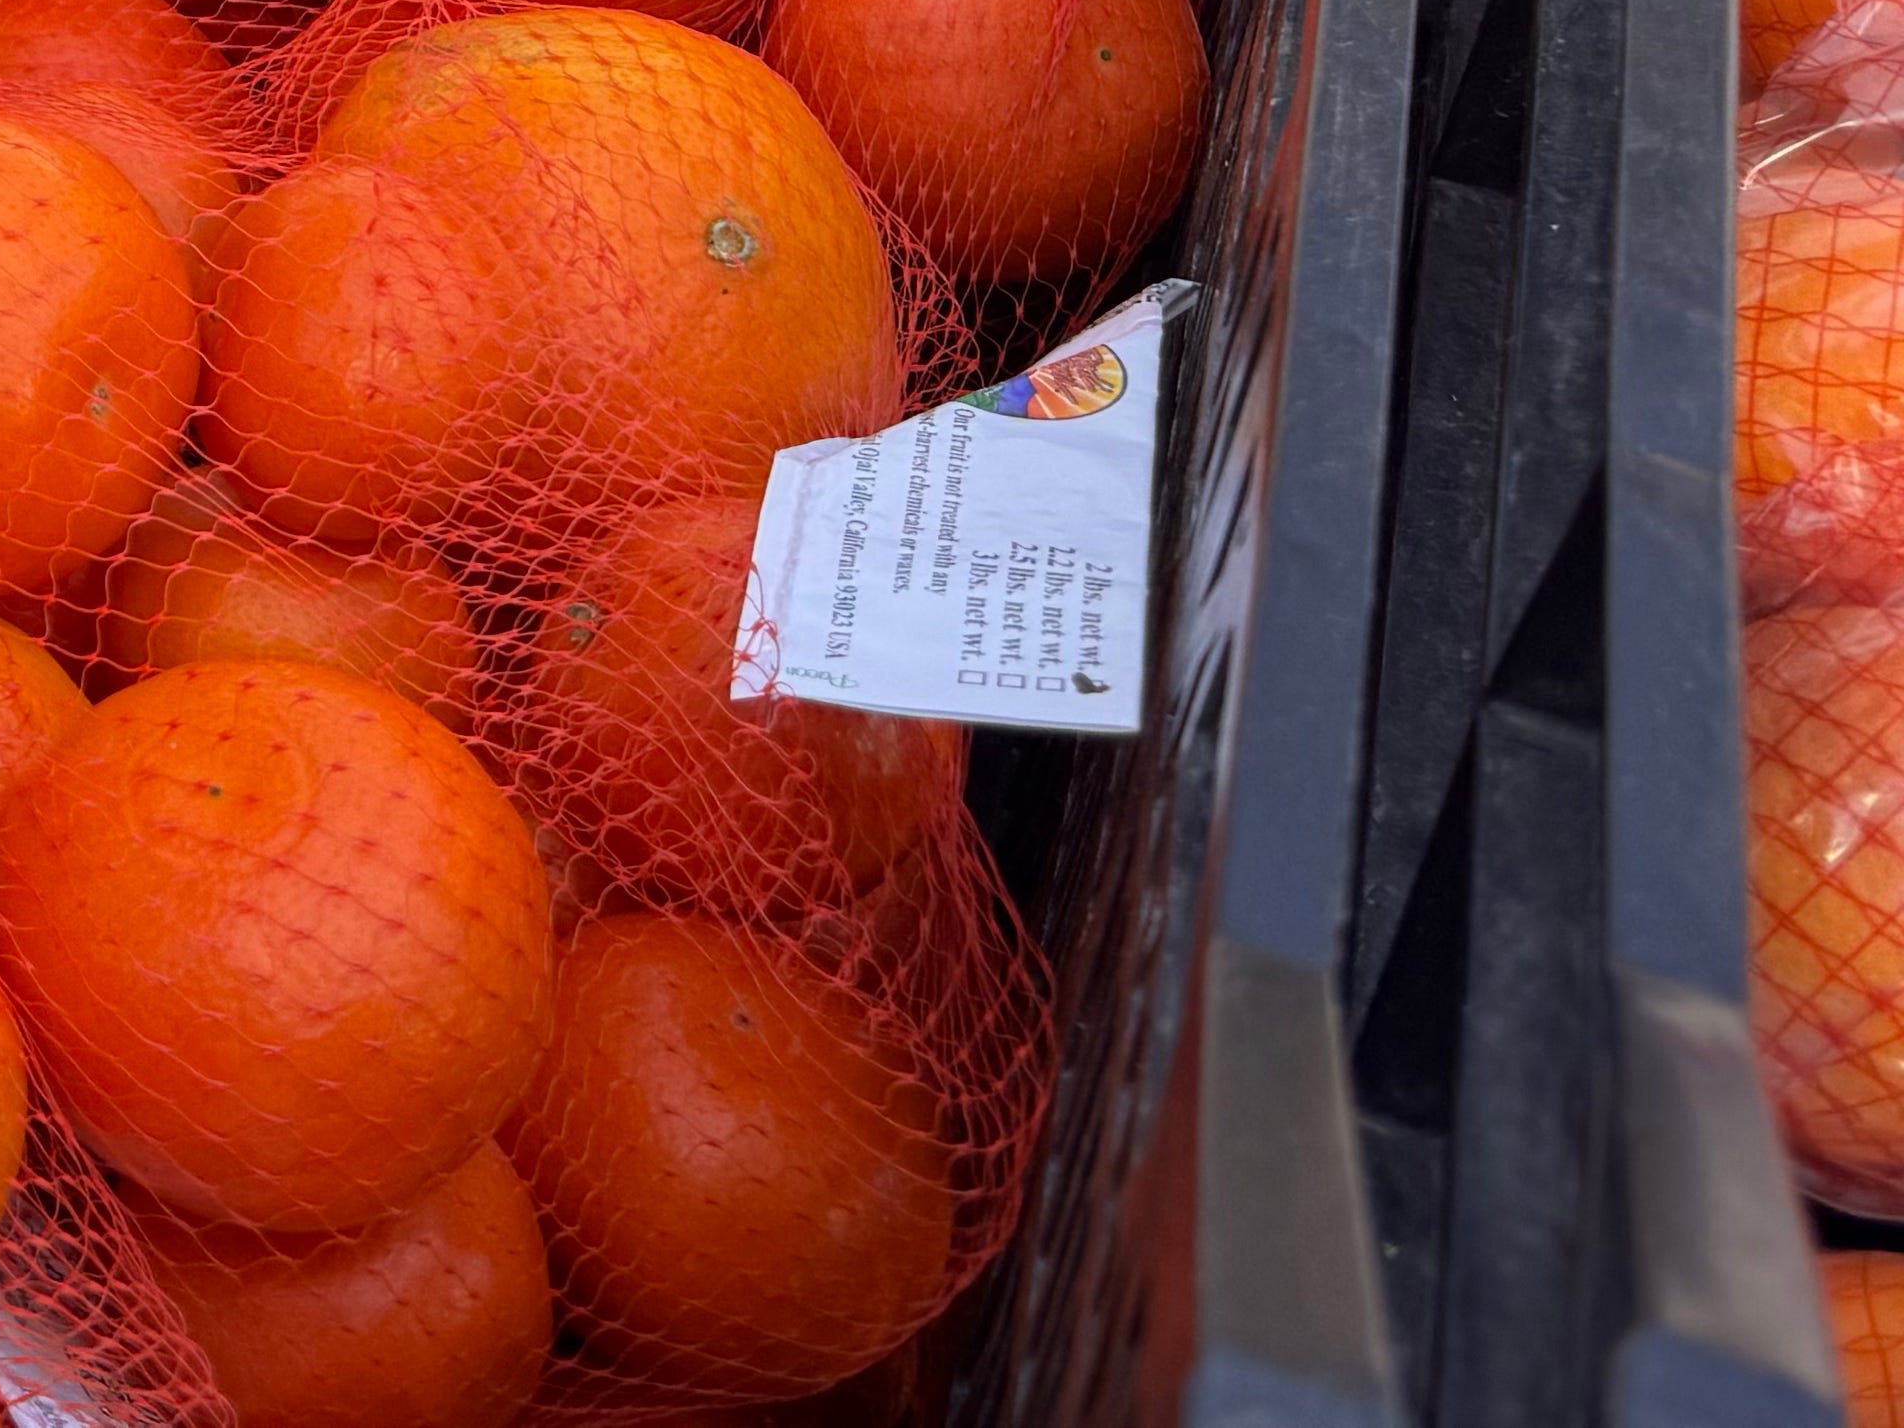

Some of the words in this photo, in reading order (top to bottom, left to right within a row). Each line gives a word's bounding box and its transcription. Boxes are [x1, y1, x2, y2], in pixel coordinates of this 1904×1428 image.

[953, 408, 976, 431] Our
[852, 447, 880, 474] Ojai
[949, 434, 972, 461] fruit
[947, 463, 969, 473] is
[842, 476, 876, 517] Valley,
[944, 475, 963, 497] not
[901, 475, 931, 536] chemicals
[938, 499, 962, 543] treated
[836, 519, 868, 581] California
[899, 538, 917, 551] or
[933, 544, 957, 569] with
[972, 550, 1000, 560] 3
[1009, 541, 1039, 565] 2.5
[1048, 545, 1076, 568] 2.2
[968, 562, 998, 590] lbs.
[1005, 566, 1036, 596] lbs.
[1084, 561, 1113, 574] 2
[923, 571, 949, 595] any
[1044, 571, 1074, 600] lbs.
[1082, 575, 1113, 605] lbs.
[831, 585, 859, 628] 93023
[964, 596, 989, 628] net
[1002, 600, 1027, 631] net
[1040, 605, 1065, 638] net
[1079, 611, 1104, 641] net
[824, 631, 853, 660] USA
